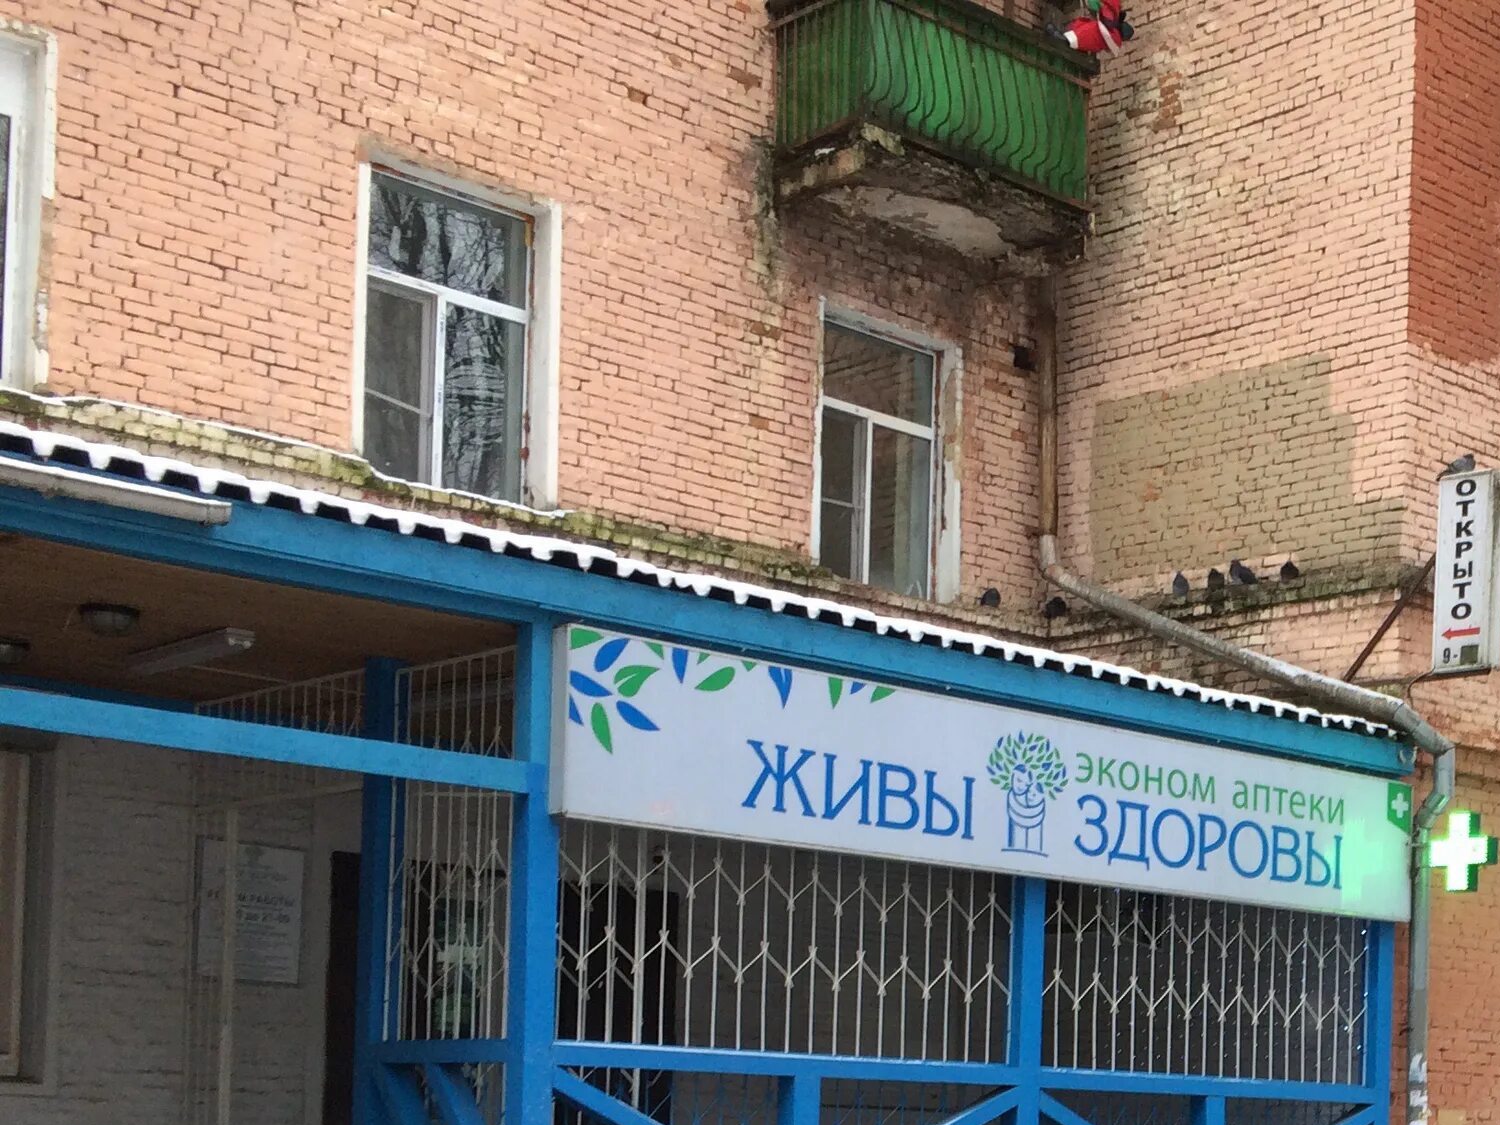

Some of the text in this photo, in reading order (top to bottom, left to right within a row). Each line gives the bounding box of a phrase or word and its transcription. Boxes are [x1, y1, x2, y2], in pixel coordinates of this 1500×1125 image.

[1451, 479, 1477, 620] ОТКРЫТО
[742, 739, 976, 840] ЖИВЫ
[1075, 752, 1345, 826] эконом аптеки
[1074, 794, 1343, 890] ЗДОРОВЫ
